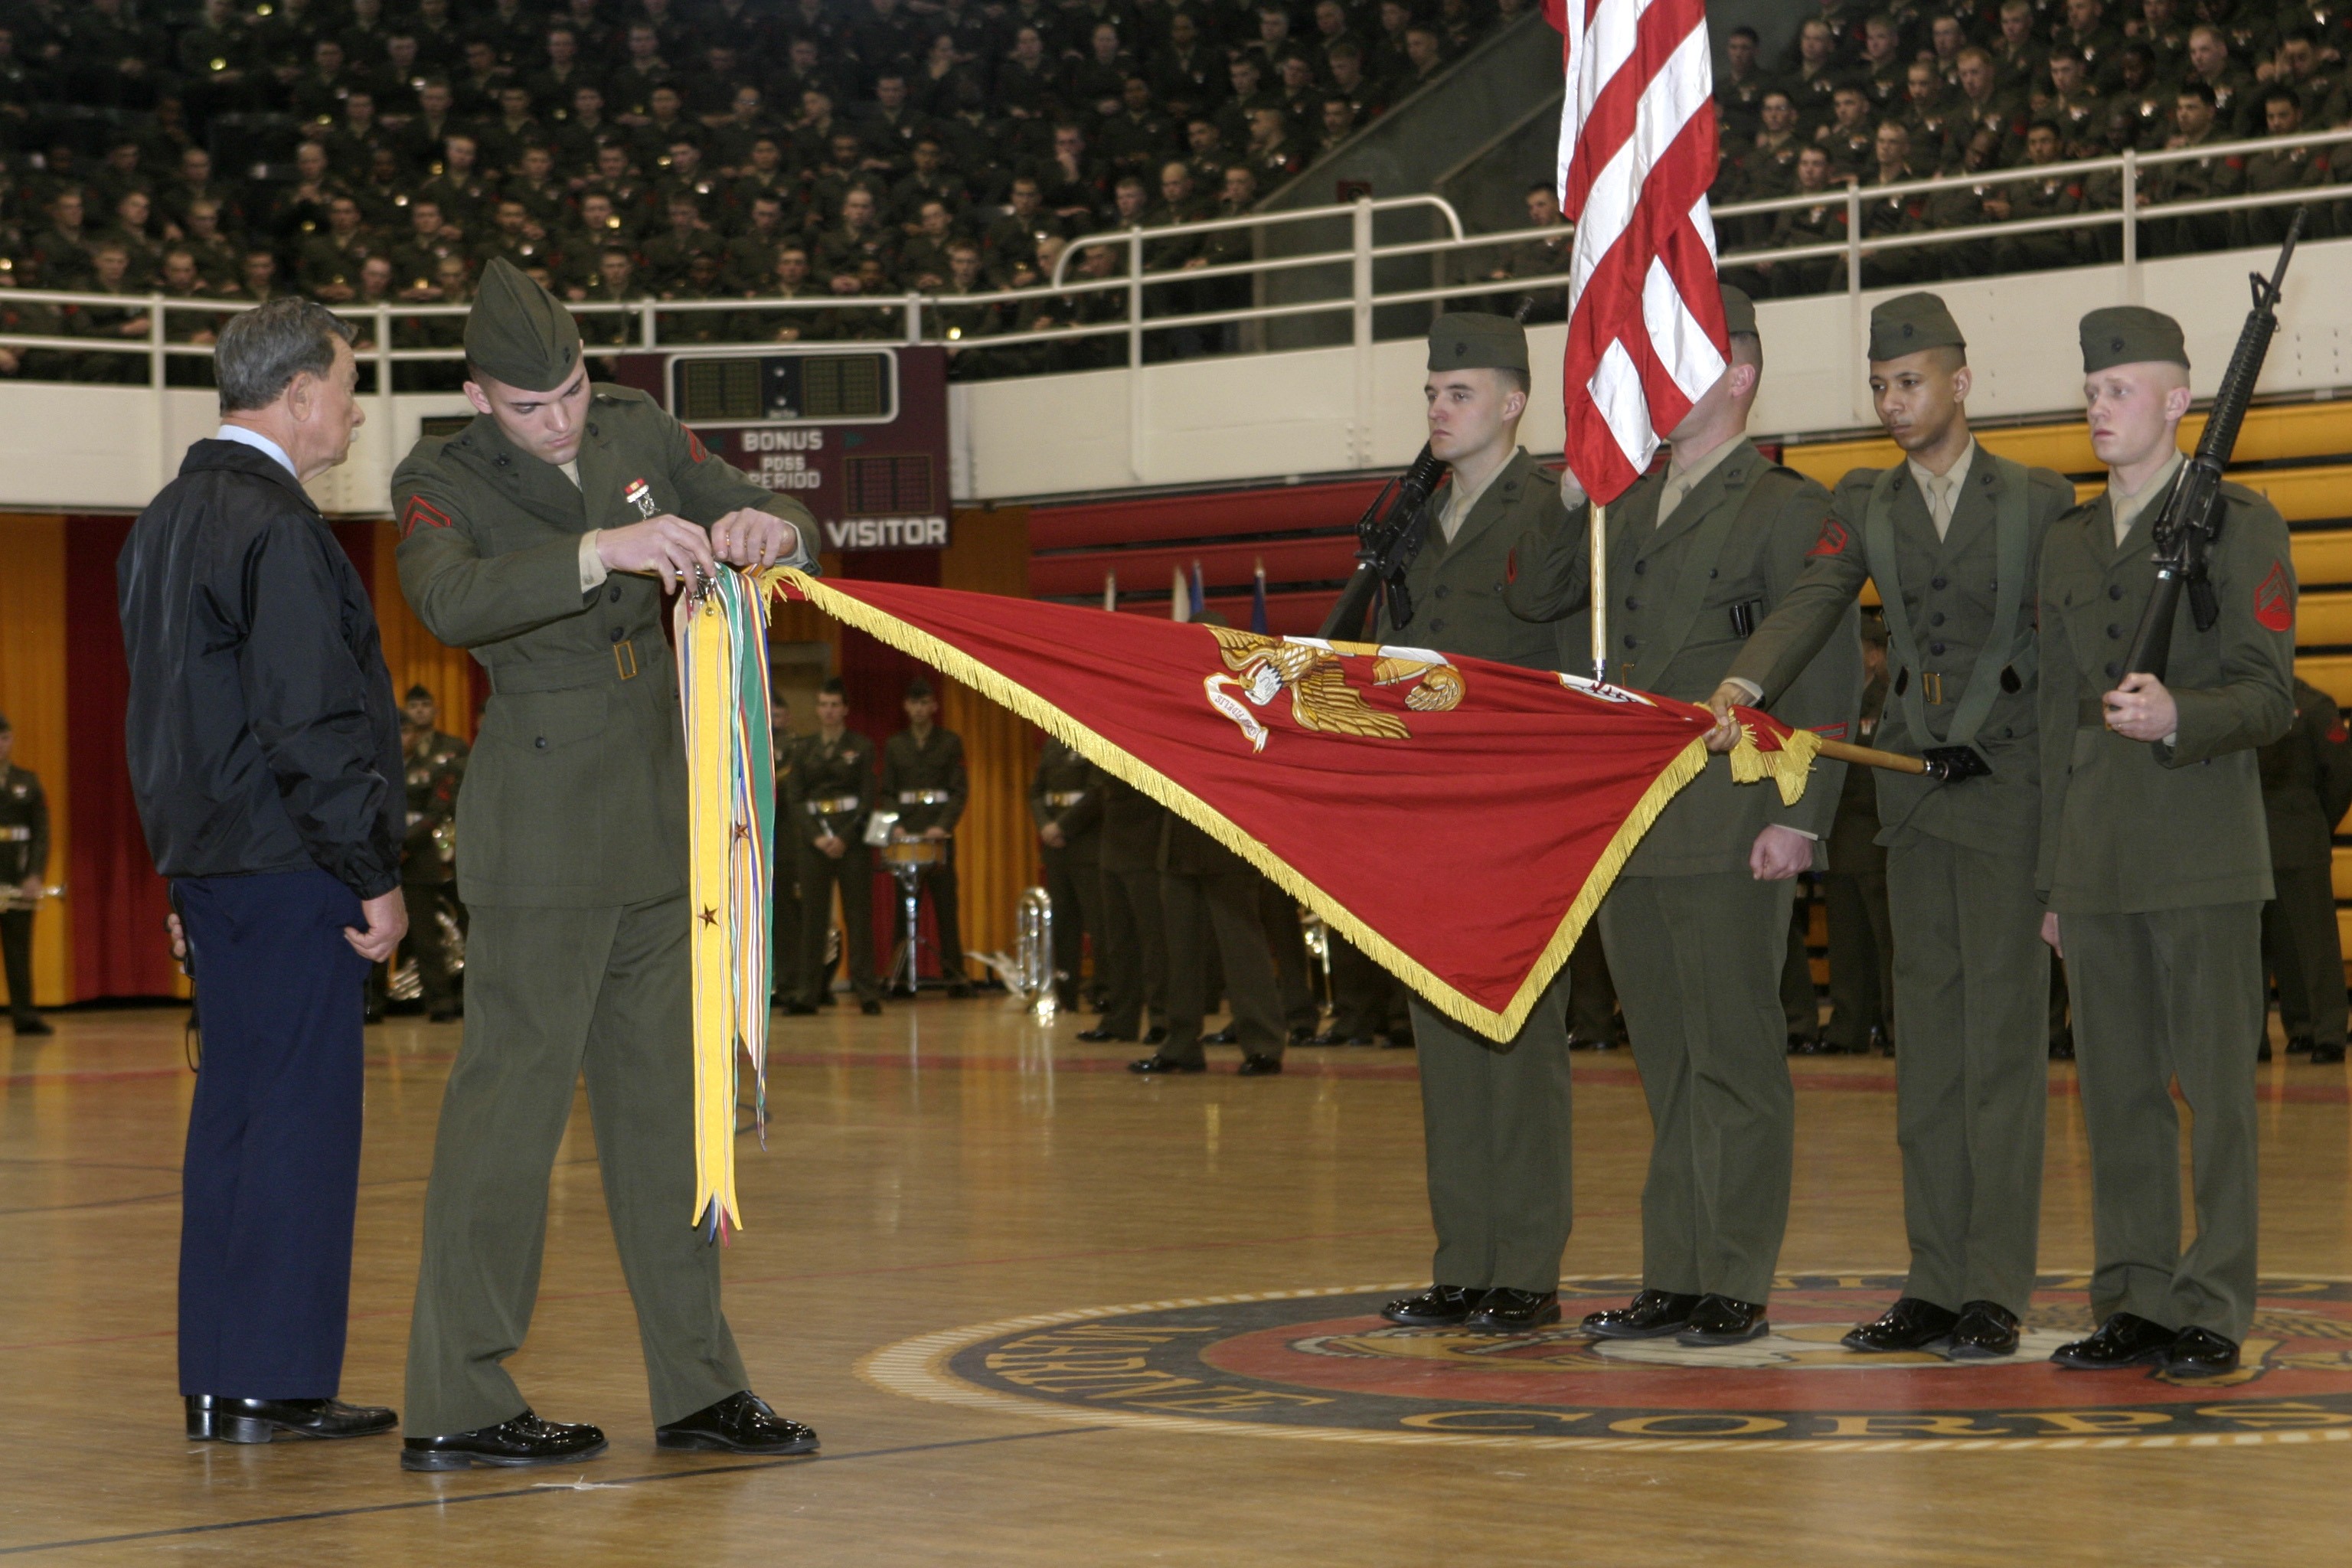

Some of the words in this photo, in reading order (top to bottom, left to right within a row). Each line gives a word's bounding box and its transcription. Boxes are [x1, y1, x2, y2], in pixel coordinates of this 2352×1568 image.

[743, 430, 822, 452] BONUS
[762, 456, 805, 472] POSS
[748, 472, 820, 489] PERIOD
[825, 518, 947, 547] VISITOR
[1215, 695, 1244, 719] FIDELIS
[985, 1324, 1335, 1413] MARINE
[1399, 1402, 2352, 1438] CORPS
